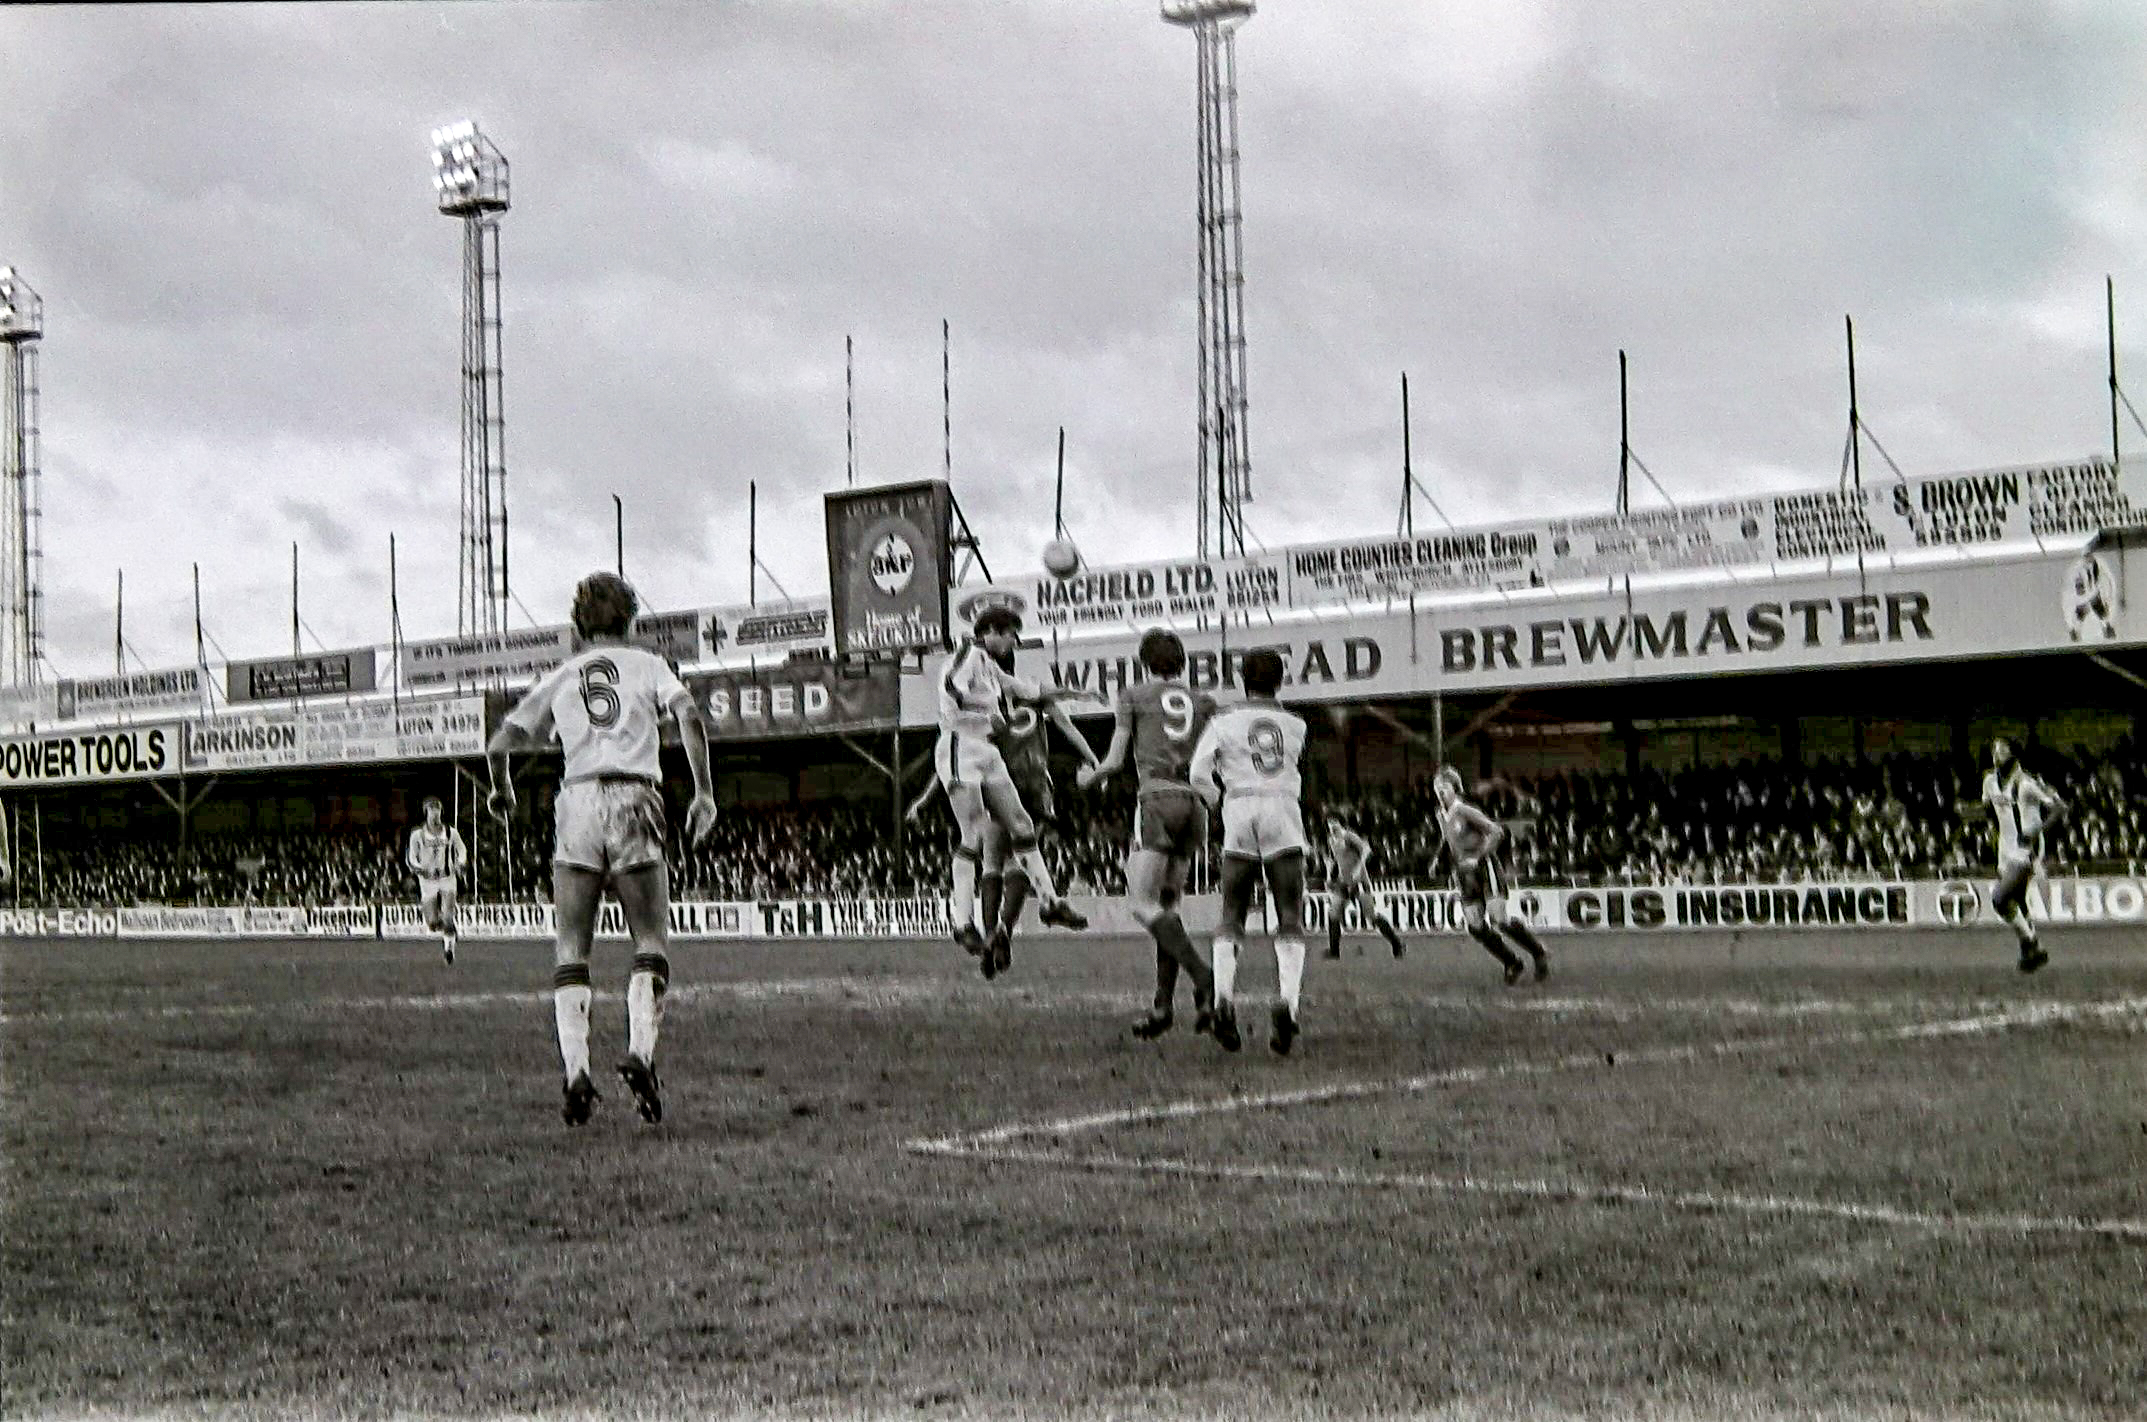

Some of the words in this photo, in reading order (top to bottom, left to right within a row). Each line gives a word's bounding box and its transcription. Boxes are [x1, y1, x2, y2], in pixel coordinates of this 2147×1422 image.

[1920, 472, 2019, 514] BROWN
[1440, 591, 1935, 674] BREWMASTER
[578, 656, 621, 730] 6
[1160, 689, 1194, 740] 9
[80, 729, 166, 777] TOOLS
[1248, 716, 1285, 777] 9
[1677, 885, 1909, 927] INSURANCE
